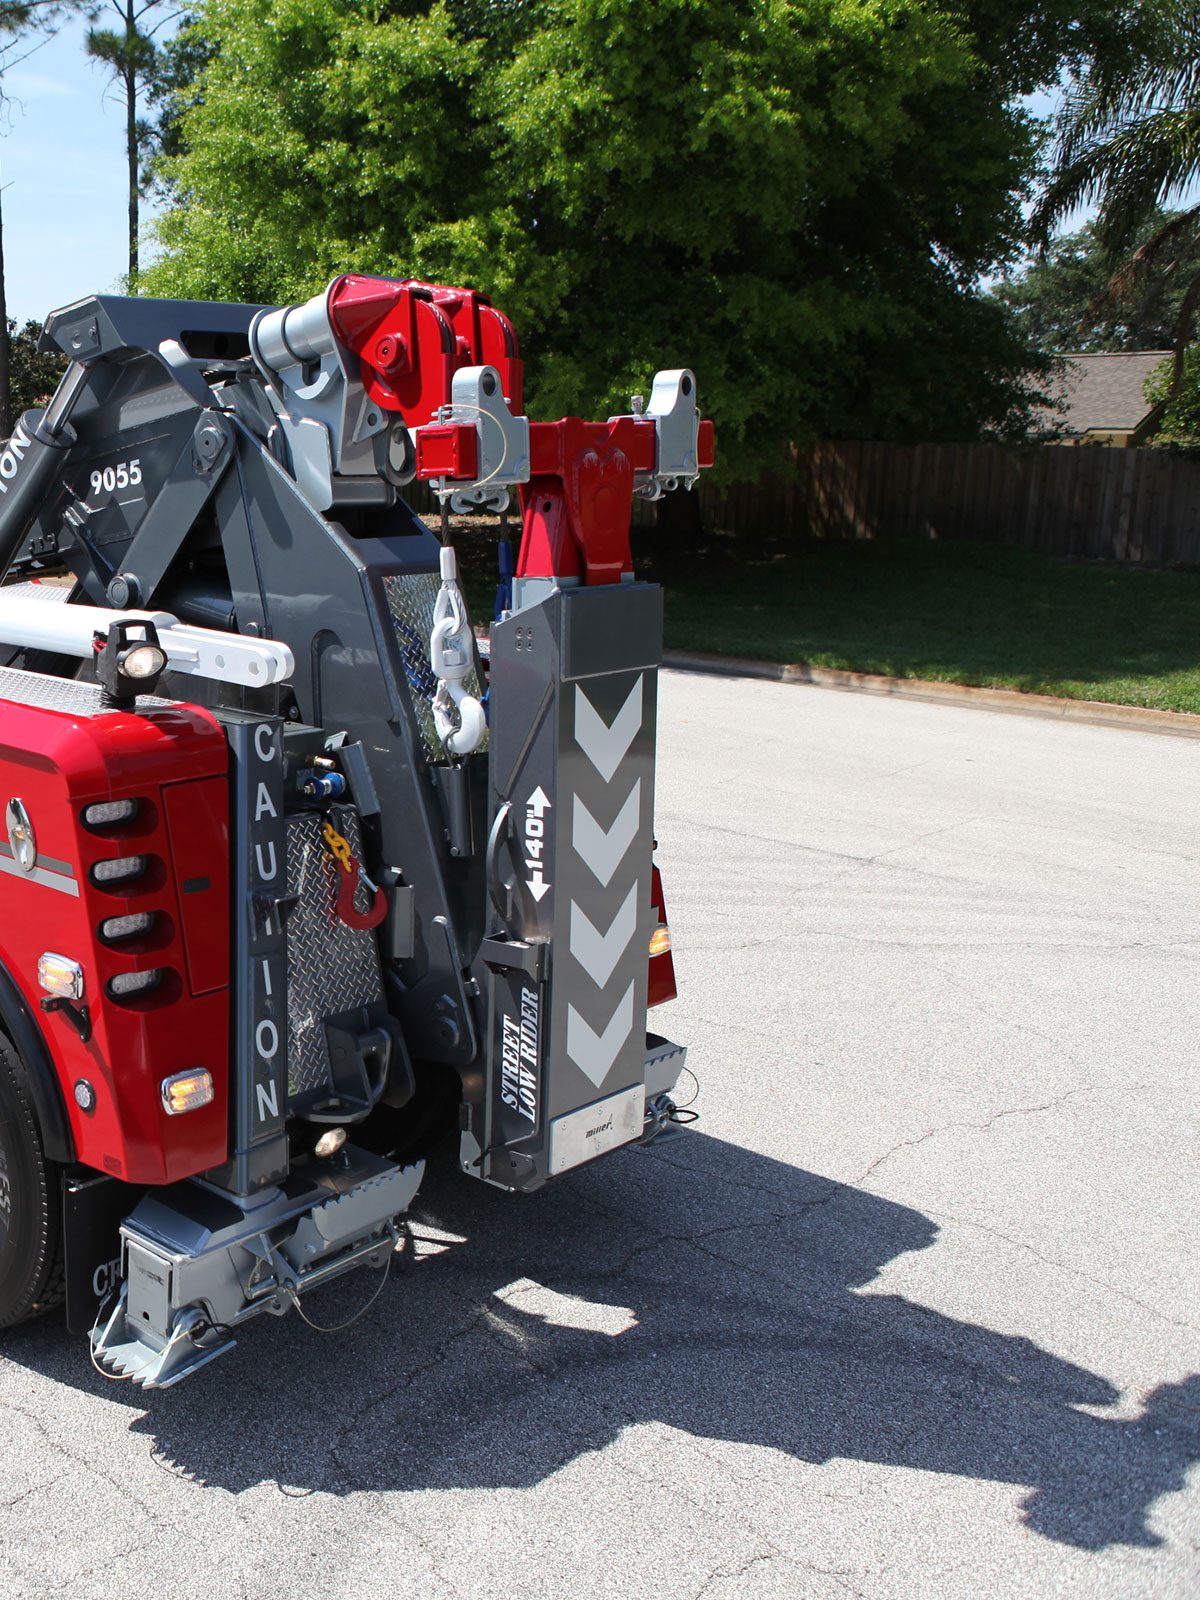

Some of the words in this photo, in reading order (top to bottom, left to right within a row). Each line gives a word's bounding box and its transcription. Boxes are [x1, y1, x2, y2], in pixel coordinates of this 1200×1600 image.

[90, 458, 142, 495] 9055
[501, 1013, 520, 1111] STREET
[520, 987, 539, 1067] RIDER
[518, 1061, 537, 1124] LOW
